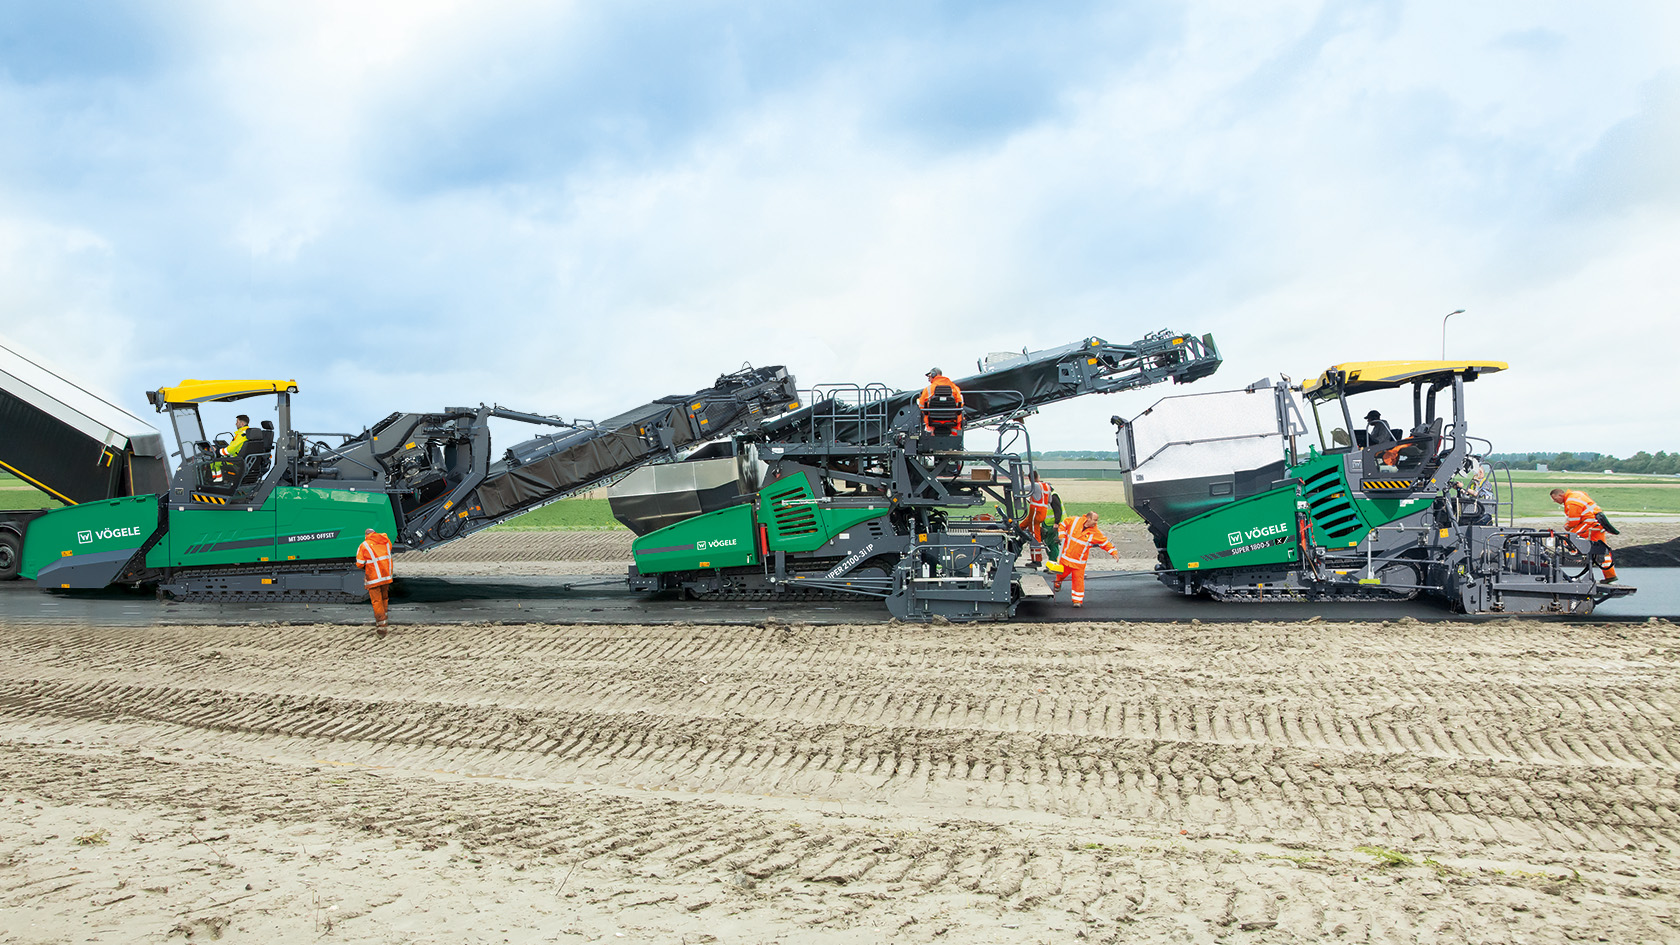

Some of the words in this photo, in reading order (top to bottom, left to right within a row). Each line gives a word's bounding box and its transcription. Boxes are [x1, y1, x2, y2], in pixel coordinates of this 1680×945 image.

[95, 527, 141, 540] VÖGELE
[316, 532, 335, 540] OFFSET
[1245, 523, 1288, 540] VÖGELE
[708, 539, 737, 548] VÖGELE
[1232, 545, 1250, 556] SUPER
[825, 566, 845, 579] UPER
[842, 548, 868, 570] 2100-3i
[865, 543, 874, 553] IP
